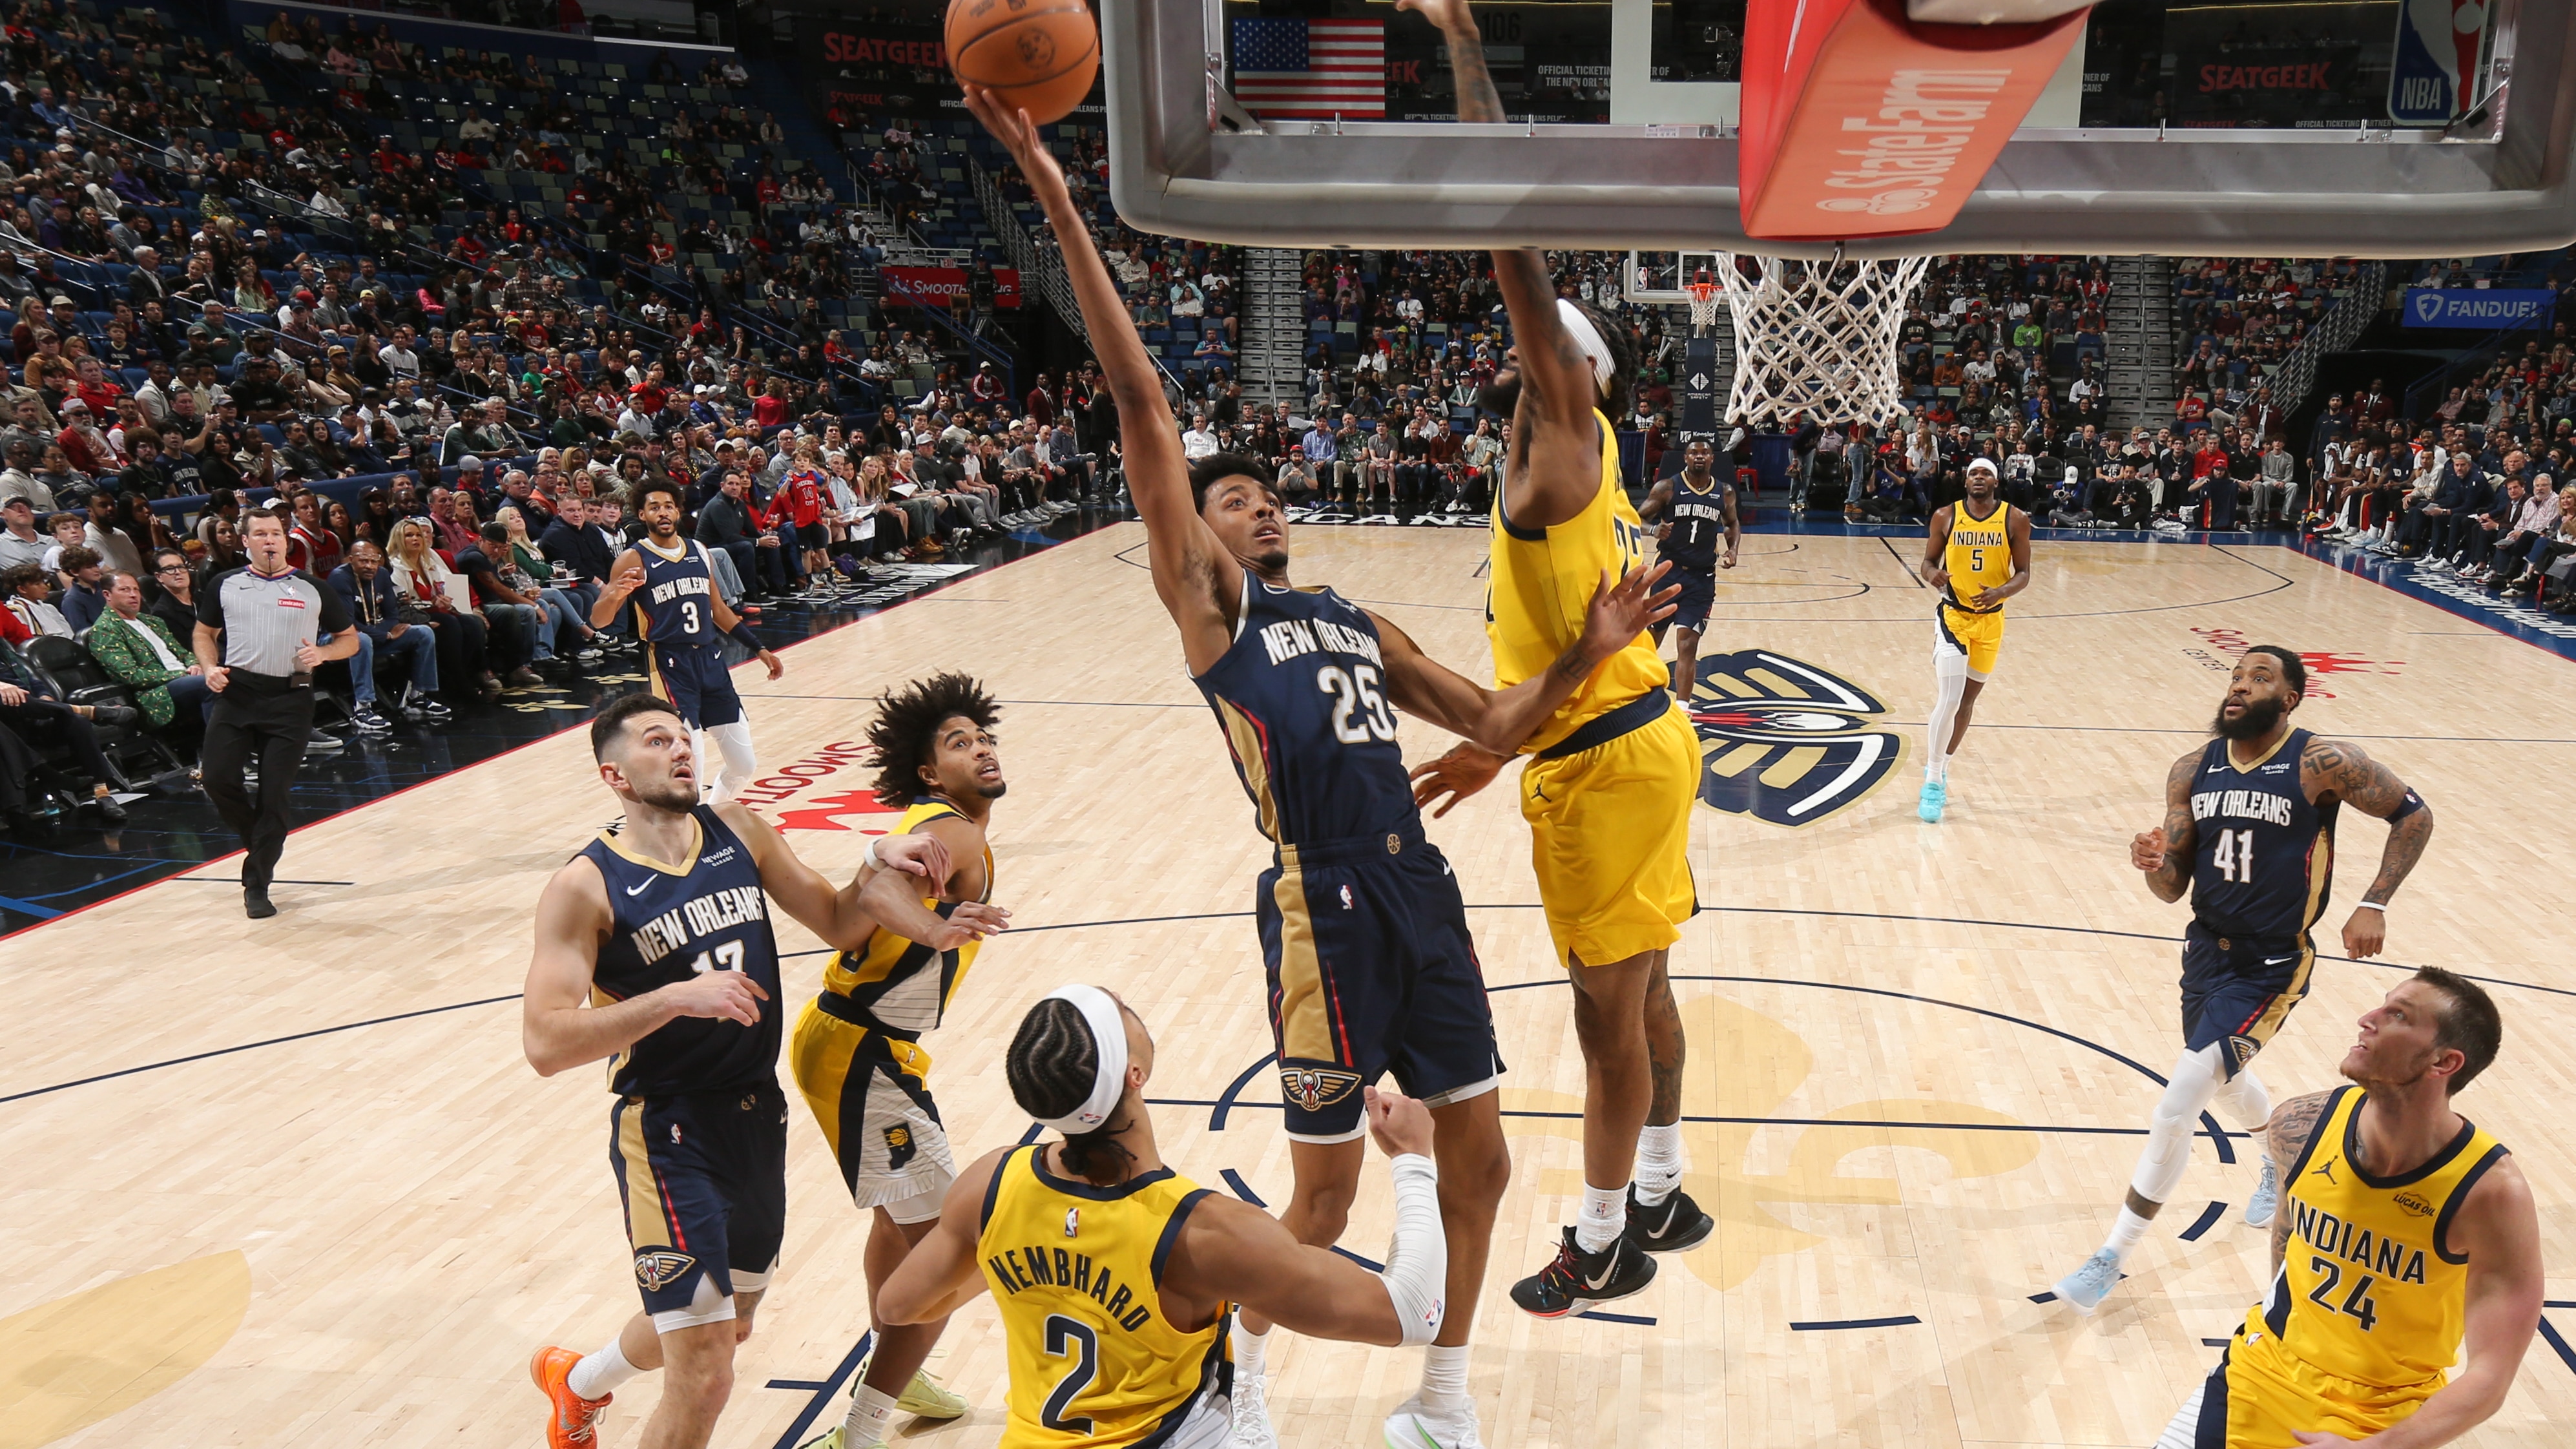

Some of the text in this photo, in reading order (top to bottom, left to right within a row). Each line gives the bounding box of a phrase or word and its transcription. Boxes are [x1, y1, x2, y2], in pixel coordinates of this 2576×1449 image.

[824, 32, 950, 68] SEATGEEK
[1538, 65, 1610, 75] OFFICIAL TICKETIN
[1546, 78, 1561, 87] THE
[2199, 61, 2331, 92] SEATGEEK
[2400, 78, 2442, 110] NBA
[2447, 301, 2541, 317] FANDUEL
[802, 487, 814, 499] 14
[1675, 504, 1720, 522] NEW ORLEANS
[1690, 520, 1699, 543] 1
[1953, 531, 2002, 547] INDIANA
[1971, 548, 1984, 572] 5
[278, 599, 304, 608] Emirates
[651, 577, 711, 605] NEW ORLEAN
[681, 601, 700, 634] 3
[1260, 620, 1318, 666] NEW
[1317, 665, 1396, 744] 25
[2191, 789, 2292, 826] NEW ORLEANS
[701, 846, 735, 864] NEWAGE
[2213, 828, 2254, 884] 41
[630, 886, 764, 965] NEW ORLEANS
[2393, 1194, 2436, 1217] LUCAS OIL
[2290, 1195, 2425, 1285] INDIANA
[988, 1246, 1151, 1333] NEMBHARD
[2309, 1255, 2377, 1332] 24
[1039, 1312, 1097, 1437] 2
